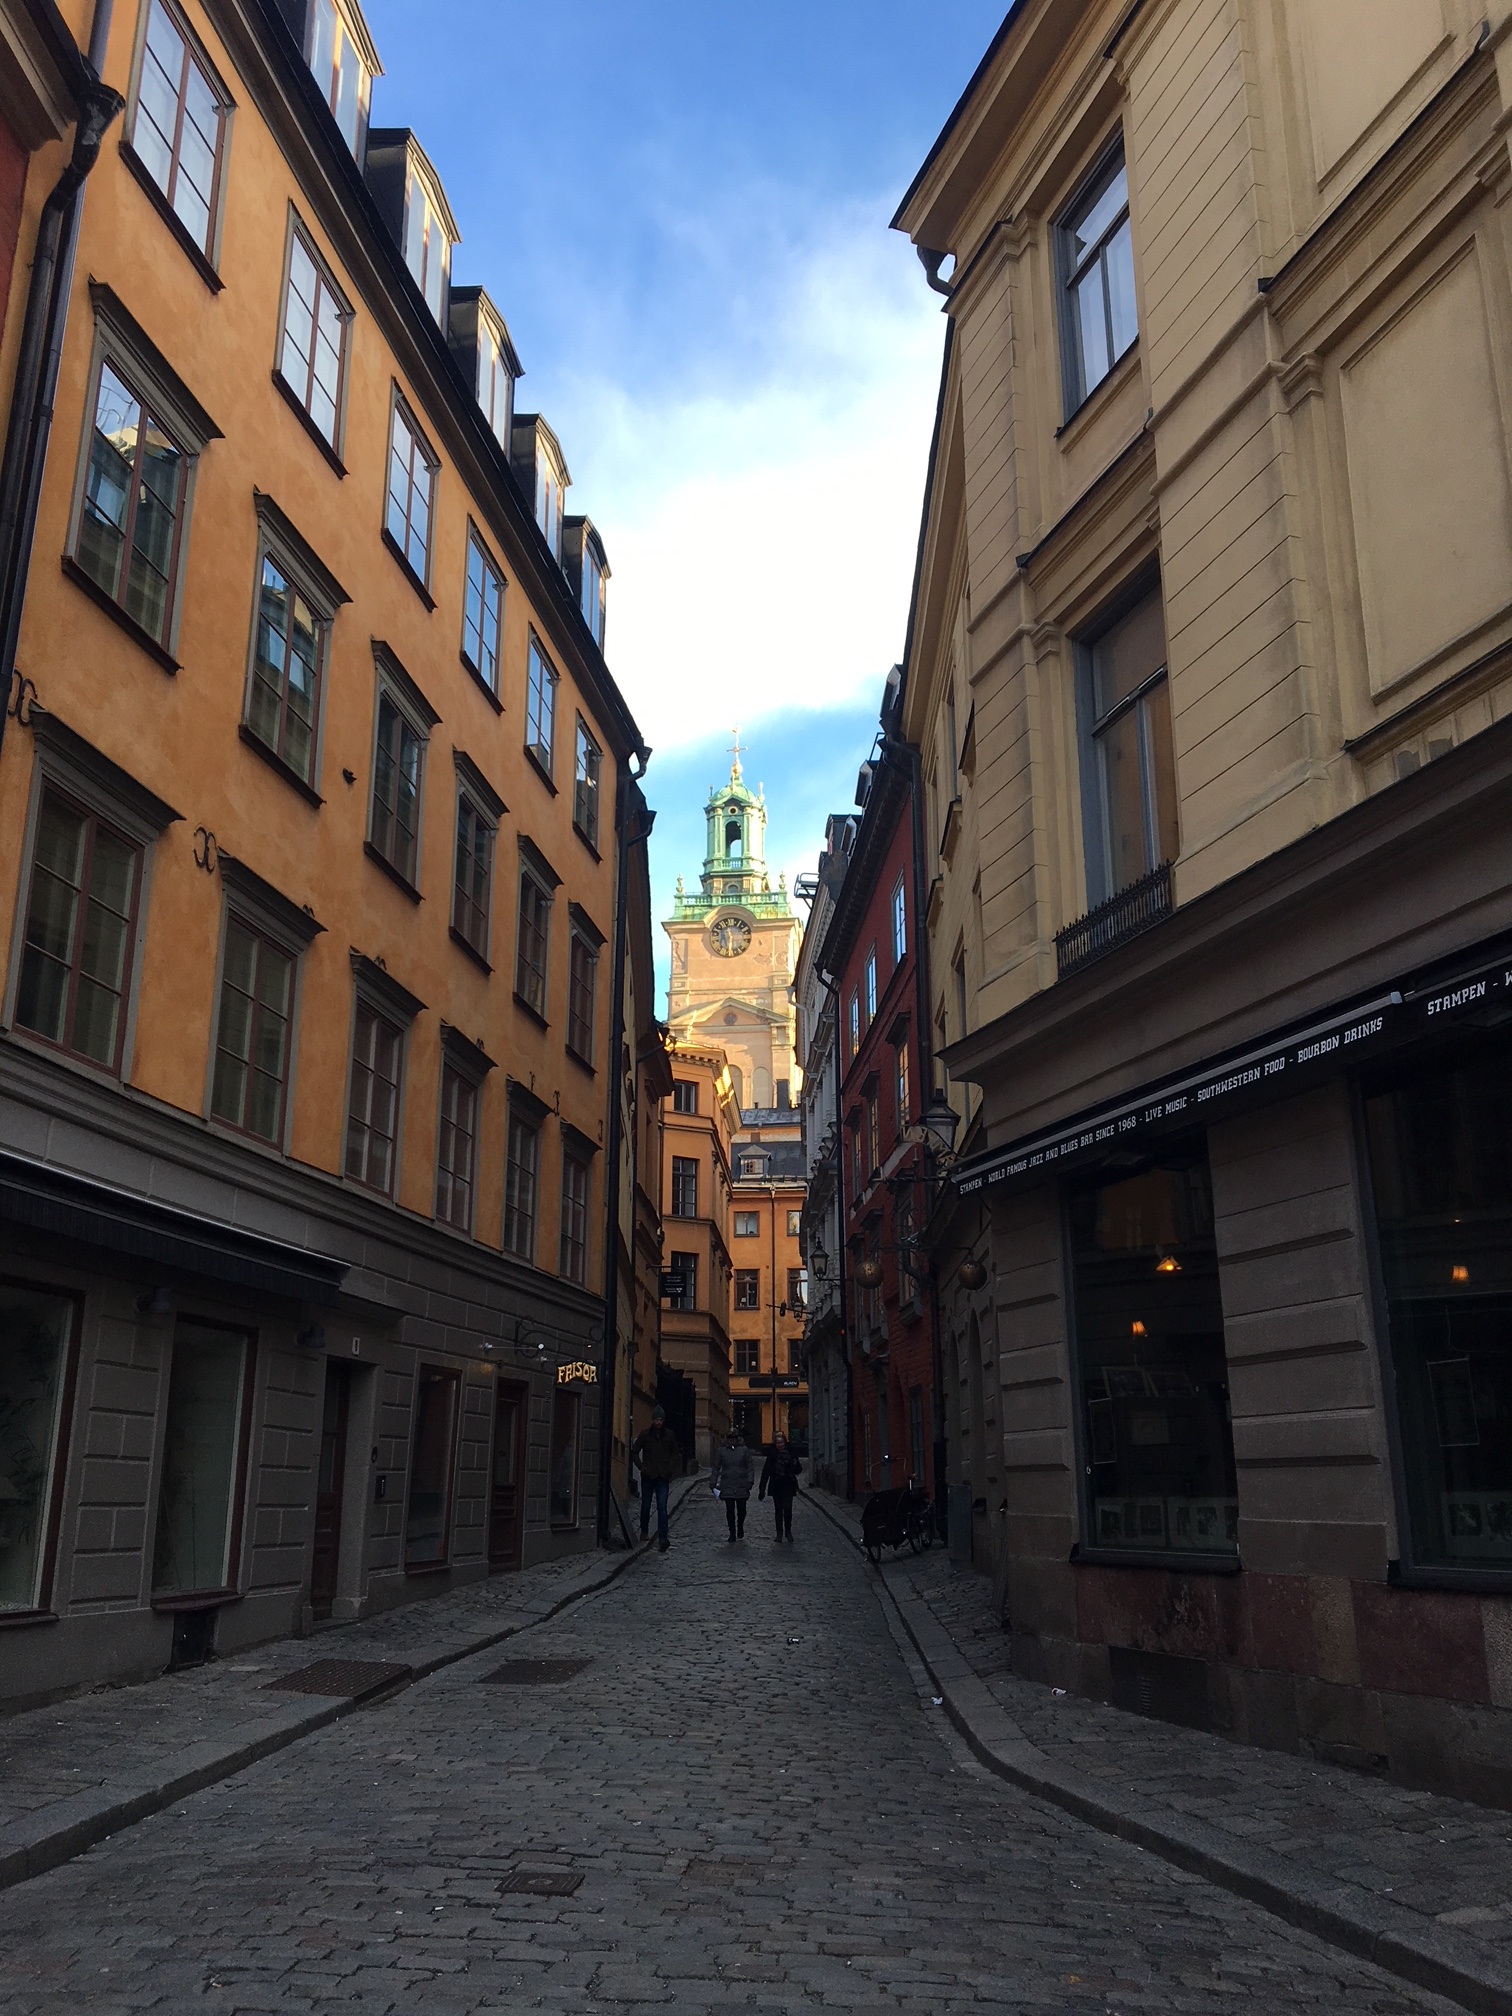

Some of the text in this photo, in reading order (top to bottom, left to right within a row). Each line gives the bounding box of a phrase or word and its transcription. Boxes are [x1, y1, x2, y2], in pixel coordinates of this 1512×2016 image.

[1427, 981, 1486, 1015] STAMPEN
[959, 1178, 982, 1194] STAMPEN
[988, 1168, 1005, 1183] WORLD
[1006, 1160, 1027, 1176] FAMOUS
[1028, 1153, 1044, 1168] JAZZ
[1045, 1147, 1059, 1161] AND
[1060, 1139, 1078, 1155] BLUES
[1080, 1133, 1094, 1147] BAR
[1095, 1124, 1115, 1141] SINCE
[1118, 1116, 1137, 1132] 1968
[1145, 1106, 1163, 1122] LIVE
[1165, 1096, 1188, 1115] MUSIC
[1197, 1067, 1261, 1102] SOUTHWESTERN
[1264, 1057, 1286, 1076] FOOD
[1297, 1035, 1340, 1063] BOURBON
[1343, 1016, 1384, 1044] DRINKS
